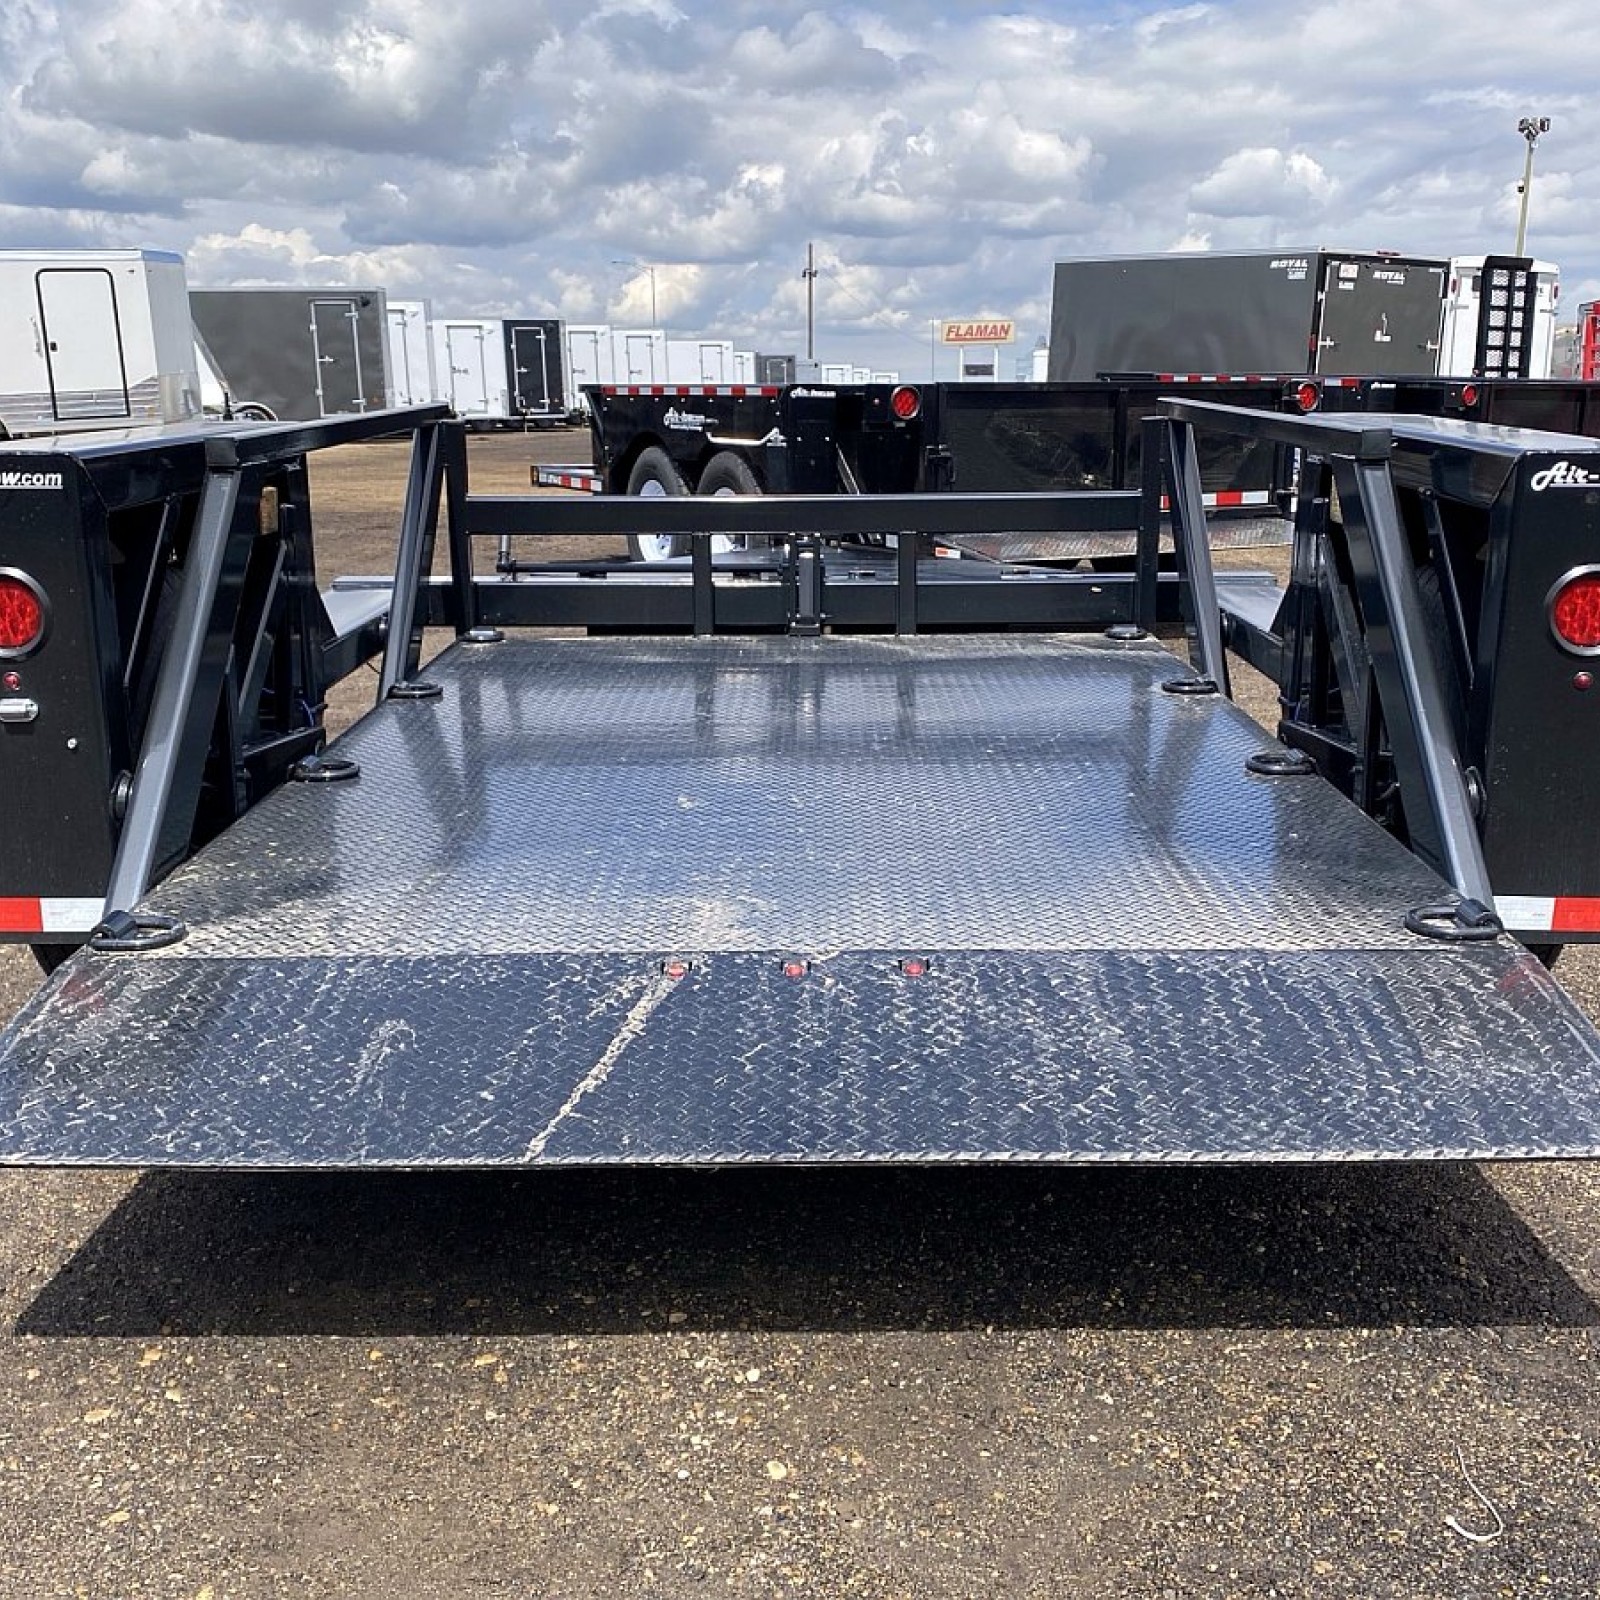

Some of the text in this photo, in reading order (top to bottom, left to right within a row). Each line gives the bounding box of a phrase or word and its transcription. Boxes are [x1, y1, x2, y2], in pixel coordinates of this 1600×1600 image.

[1270, 259, 1308, 269] ROYAL
[1373, 271, 1405, 279] ROYAL
[945, 323, 1011, 337] FLAMAN
[0, 472, 62, 486] w.com
